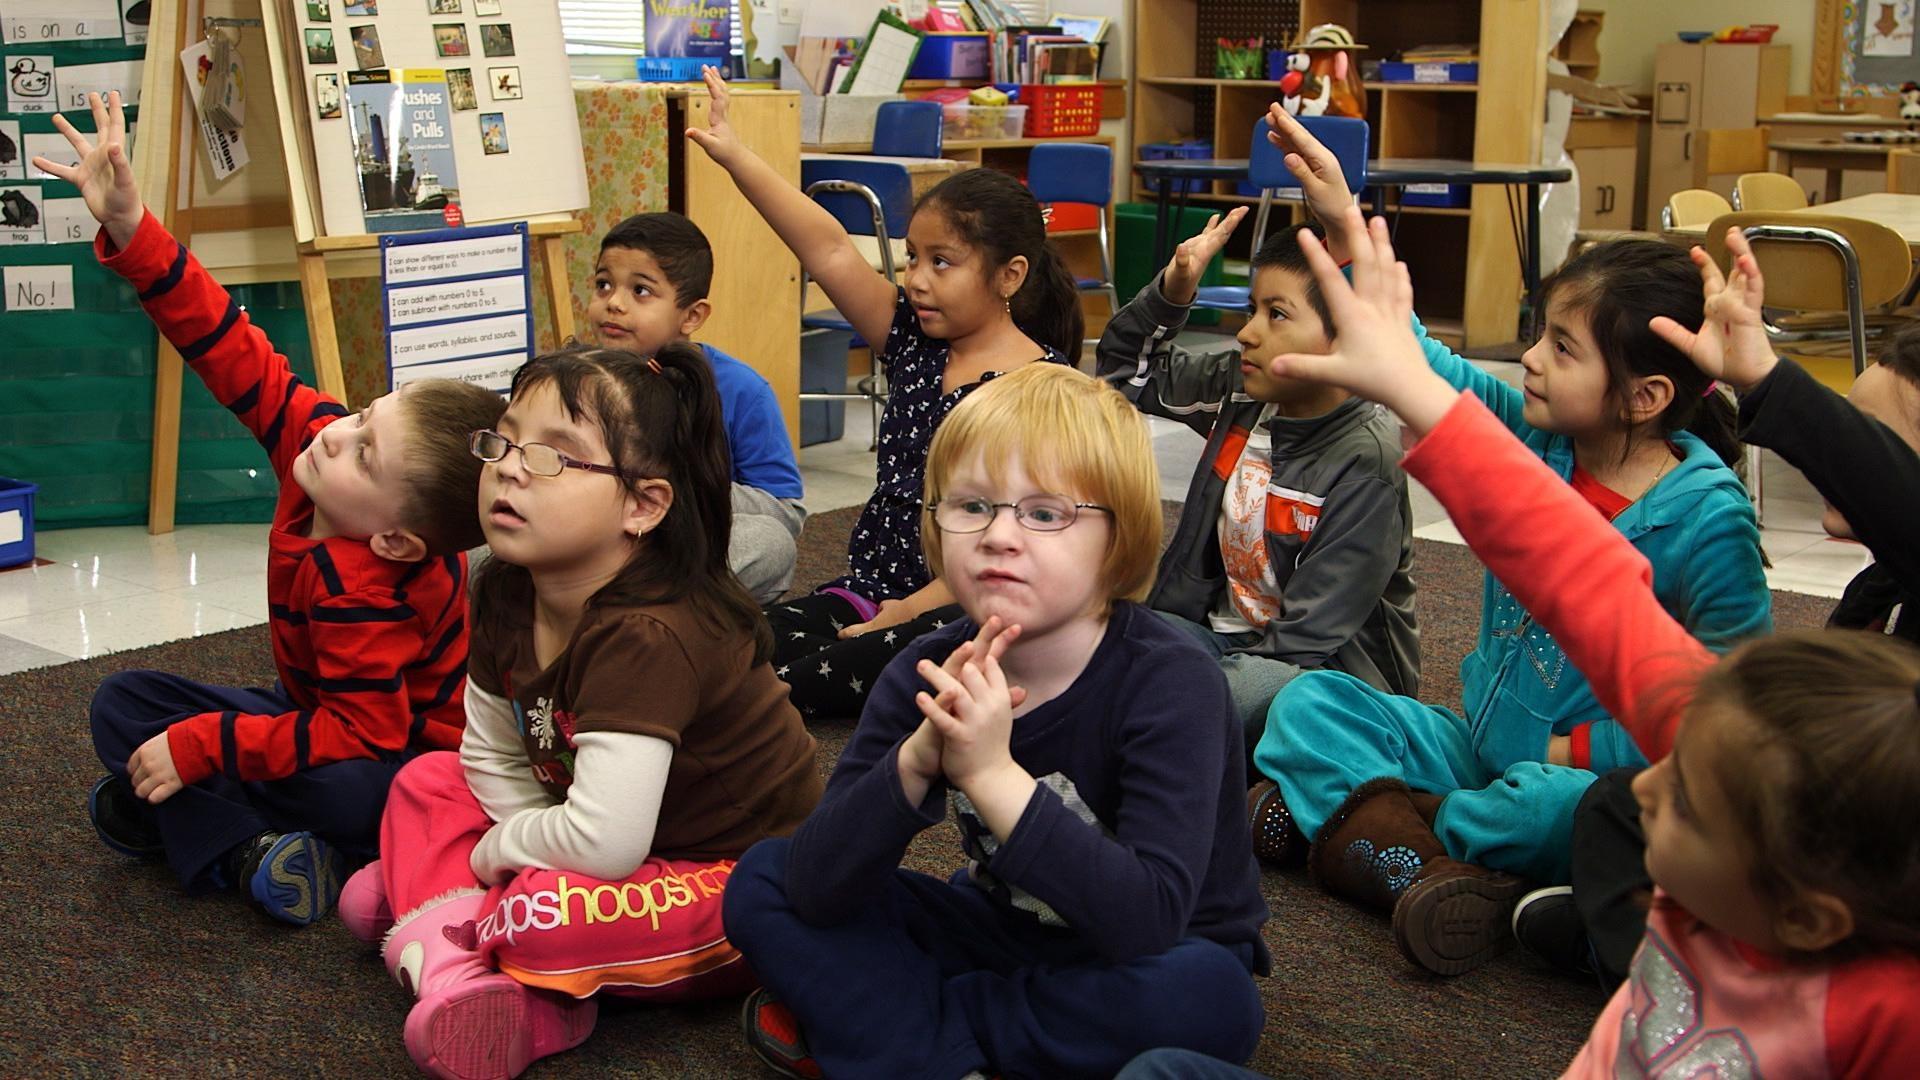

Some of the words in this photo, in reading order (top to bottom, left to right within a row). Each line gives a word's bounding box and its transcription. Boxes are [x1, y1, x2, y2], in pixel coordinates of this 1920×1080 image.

[651, 0, 728, 19] Weather
[12, 17, 27, 39] is
[41, 23, 60, 39] on
[76, 22, 90, 36] a
[71, 86, 85, 107] is
[412, 107, 435, 120] and
[412, 122, 444, 139] Pulls
[66, 217, 81, 239] is
[12, 233, 29, 242] frog
[421, 254, 445, 262] different
[428, 263, 444, 271] equal
[17, 281, 55, 307] No!
[396, 298, 409, 306] can
[410, 296, 423, 304] add
[425, 294, 438, 302] with
[439, 291, 465, 301] numbers
[466, 289, 471, 298] 0
[397, 309, 410, 317] can
[411, 305, 437, 315] subtract
[438, 303, 450, 312] with
[452, 301, 478, 310] numbers
[478, 298, 484, 307] 0
[399, 345, 413, 353] can
[414, 343, 426, 351] use
[479, 331, 493, 341] and
[464, 373, 483, 382] share
[484, 370, 498, 379] with
